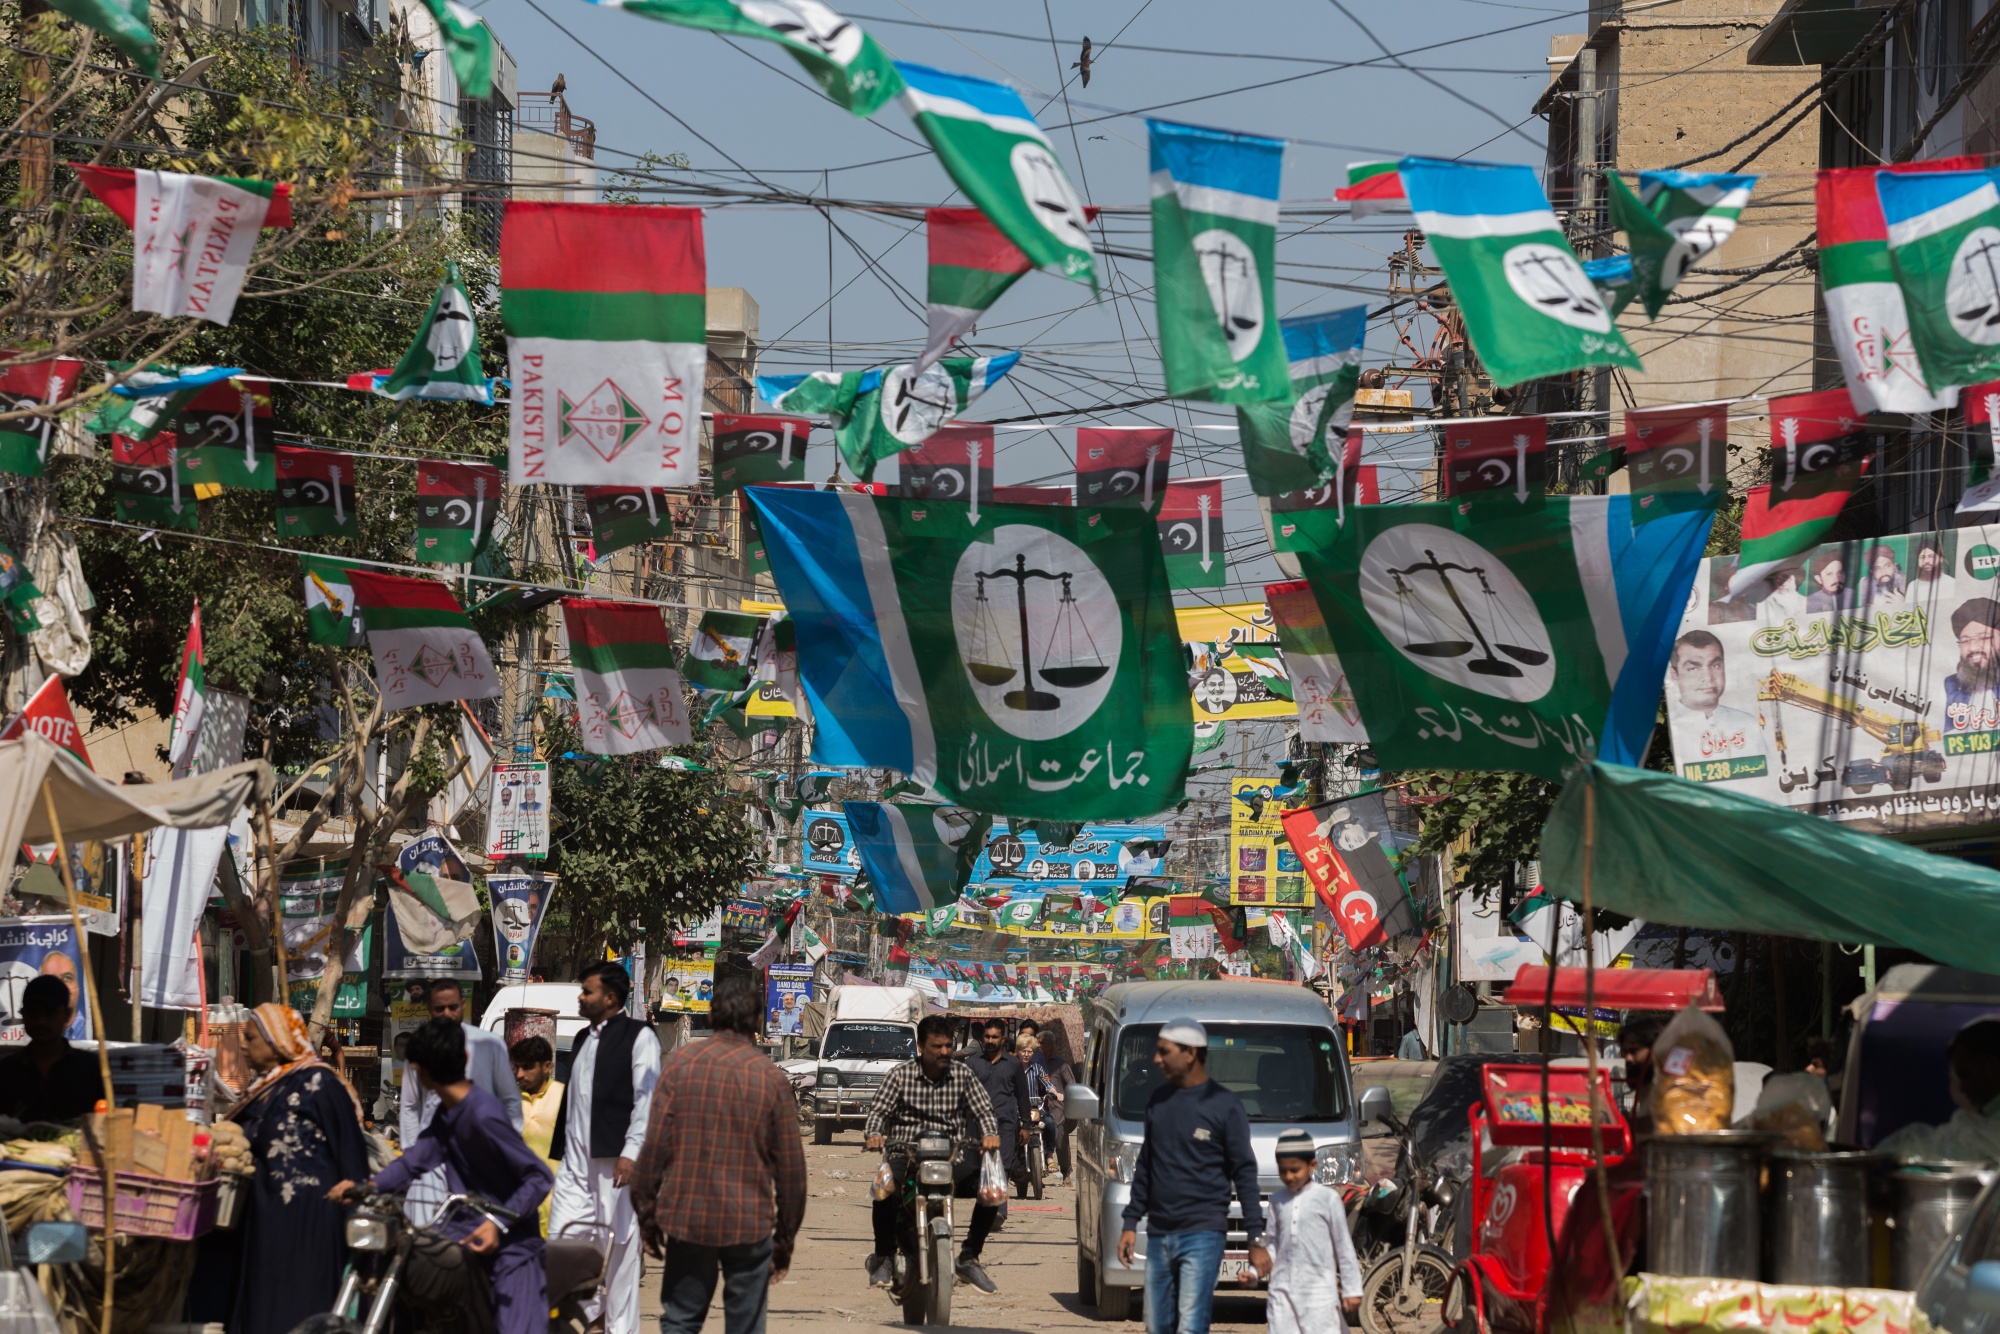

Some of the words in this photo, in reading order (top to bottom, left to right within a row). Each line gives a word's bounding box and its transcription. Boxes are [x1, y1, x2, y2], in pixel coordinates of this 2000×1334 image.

[522, 354, 545, 478] PAKISTAN
[657, 376, 684, 470] MQM
[1977, 557, 1997, 567] TLP
[1829, 665, 1868, 695] نشان
[21, 715, 75, 746] VOTE
[1948, 733, 1992, 754] PS-103
[958, 731, 1023, 791] اسلامی
[1026, 740, 1150, 791] جماعت
[1685, 761, 1731, 782] NA-238
[1074, 842, 1109, 856] جماعت
[0, 931, 26, 947] نشا
[26, 931, 37, 946] کا
[37, 929, 68, 948] کراچی
[406, 957, 430, 968] اسلامی
[430, 957, 459, 968] جماعت
